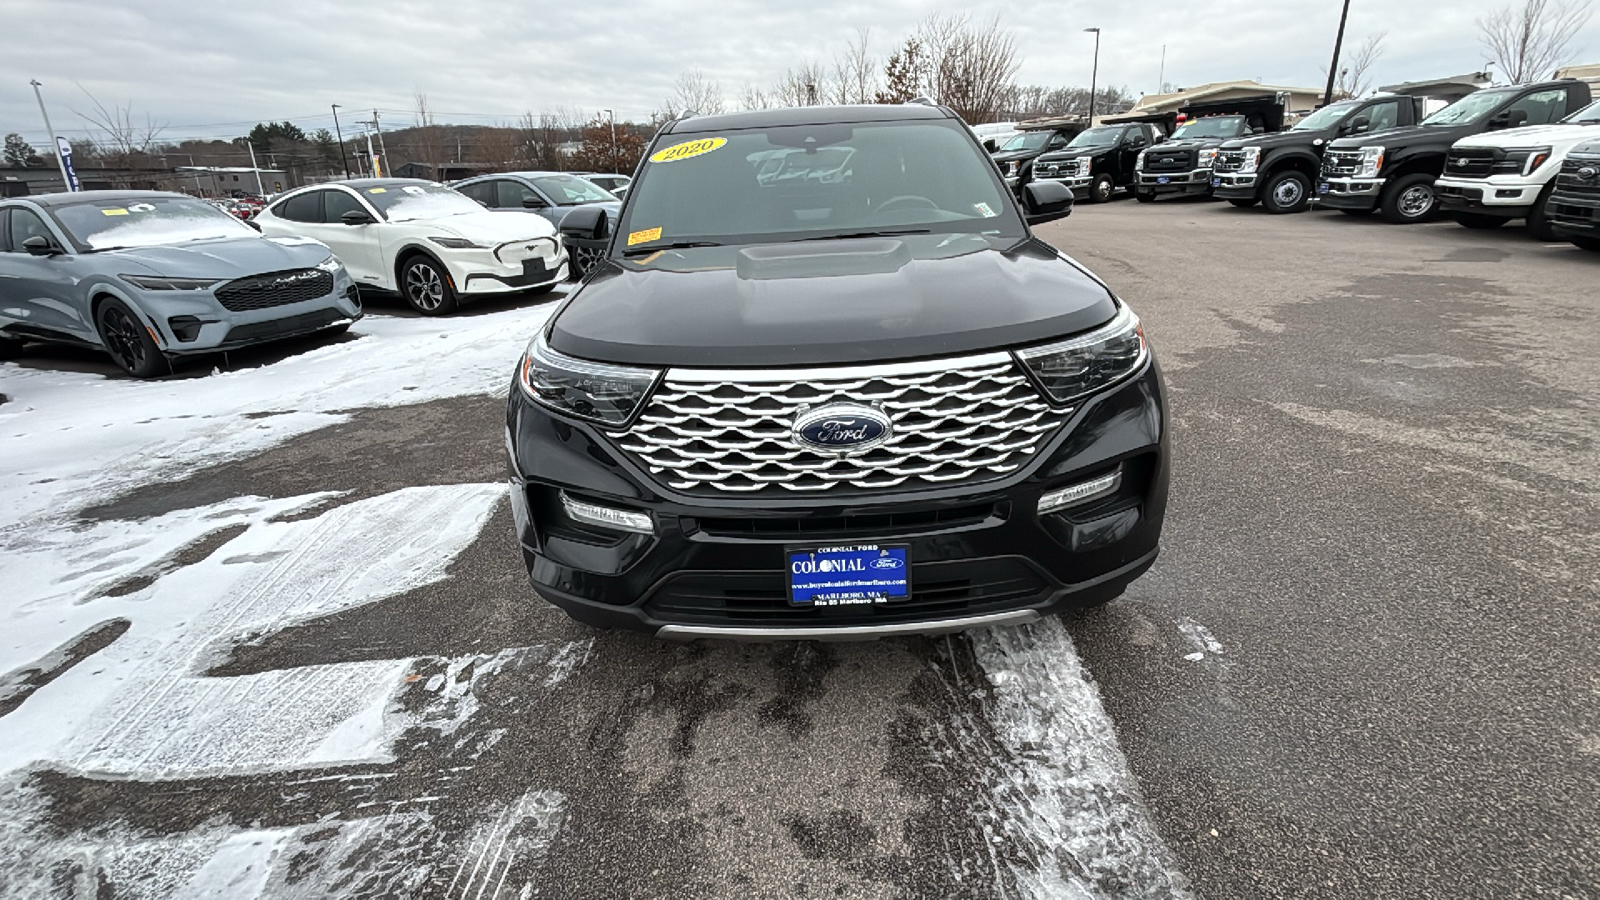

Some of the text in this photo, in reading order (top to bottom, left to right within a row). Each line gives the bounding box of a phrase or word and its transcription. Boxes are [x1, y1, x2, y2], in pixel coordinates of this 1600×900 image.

[663, 140, 713, 160] 2020
[818, 420, 867, 441] Ford
[818, 546, 854, 554] COLONIAL
[792, 559, 865, 574] COLONIAL
